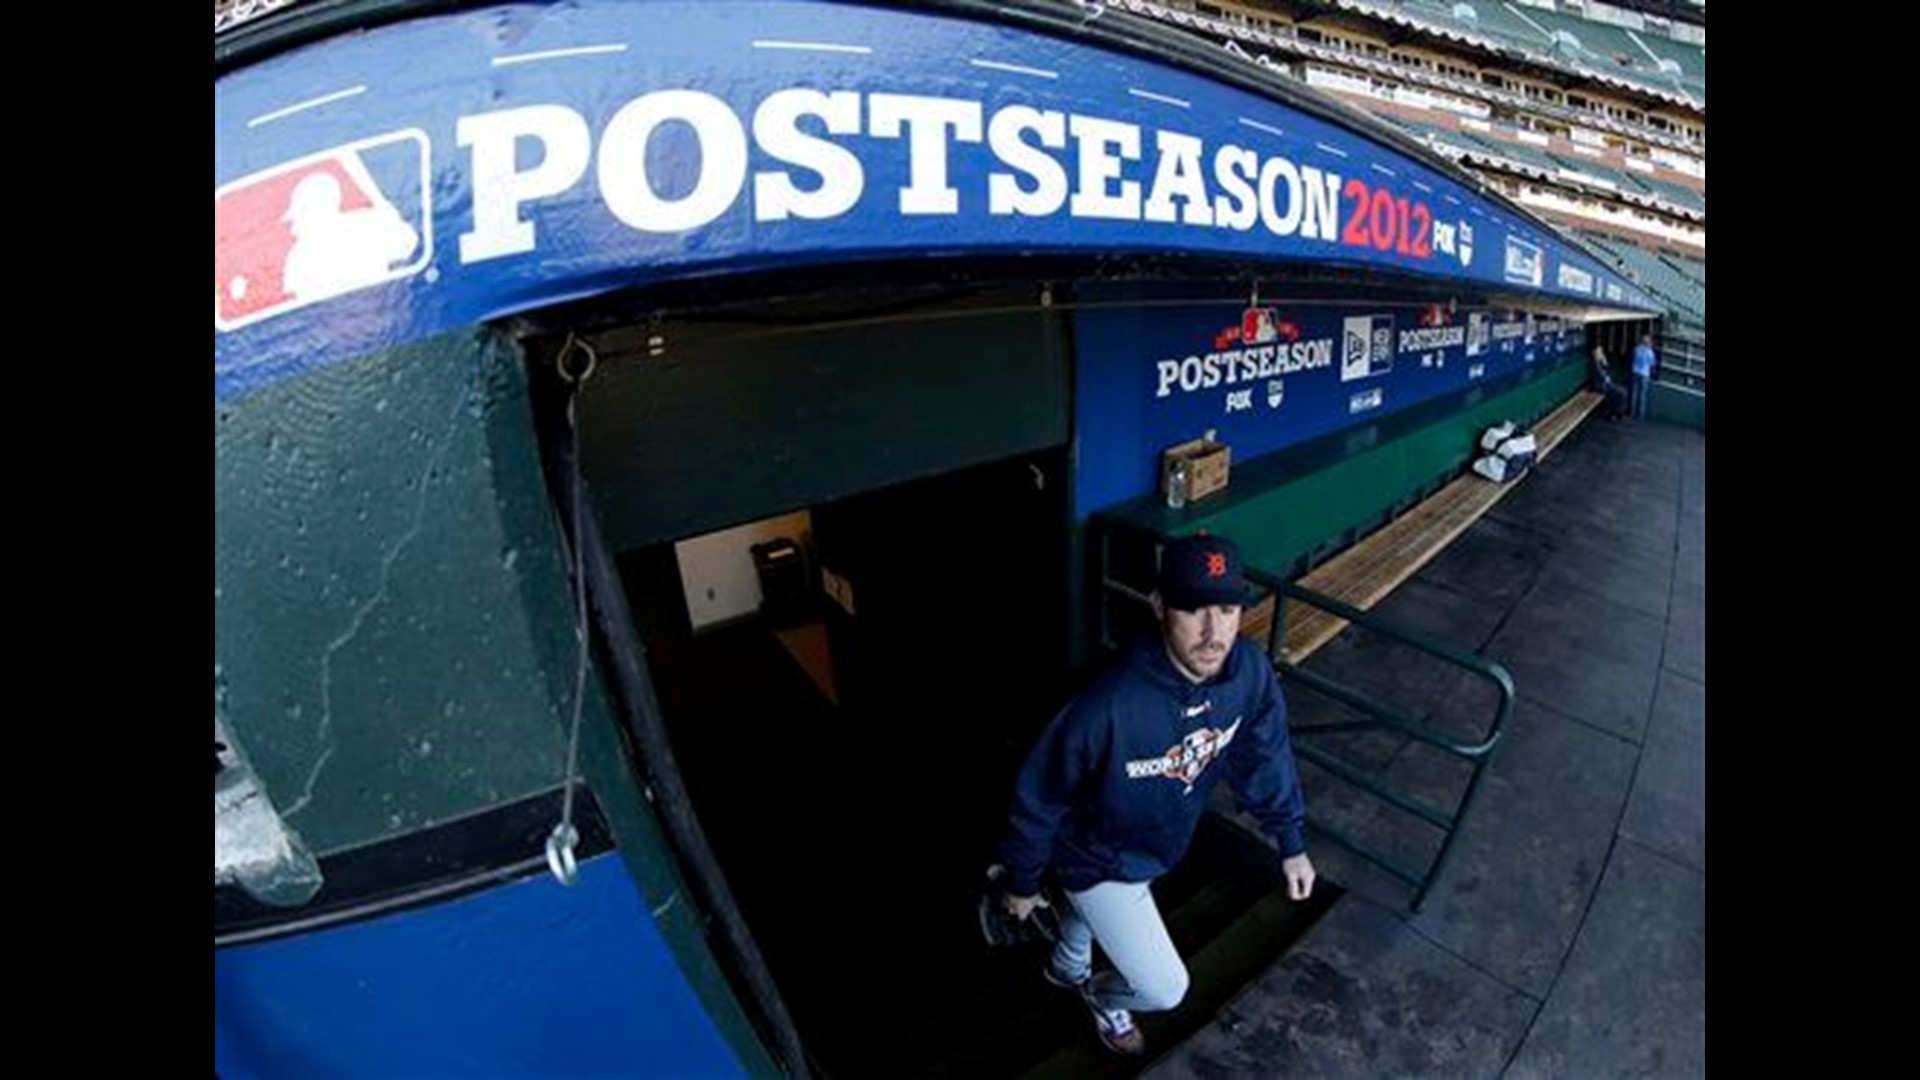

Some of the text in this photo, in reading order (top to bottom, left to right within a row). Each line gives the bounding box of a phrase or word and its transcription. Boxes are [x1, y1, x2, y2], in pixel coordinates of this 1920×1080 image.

[456, 88, 1430, 264] POSTSEASON 2012
[1157, 339, 1333, 397] POSTSEASON
[1225, 388, 1253, 412] FOX
